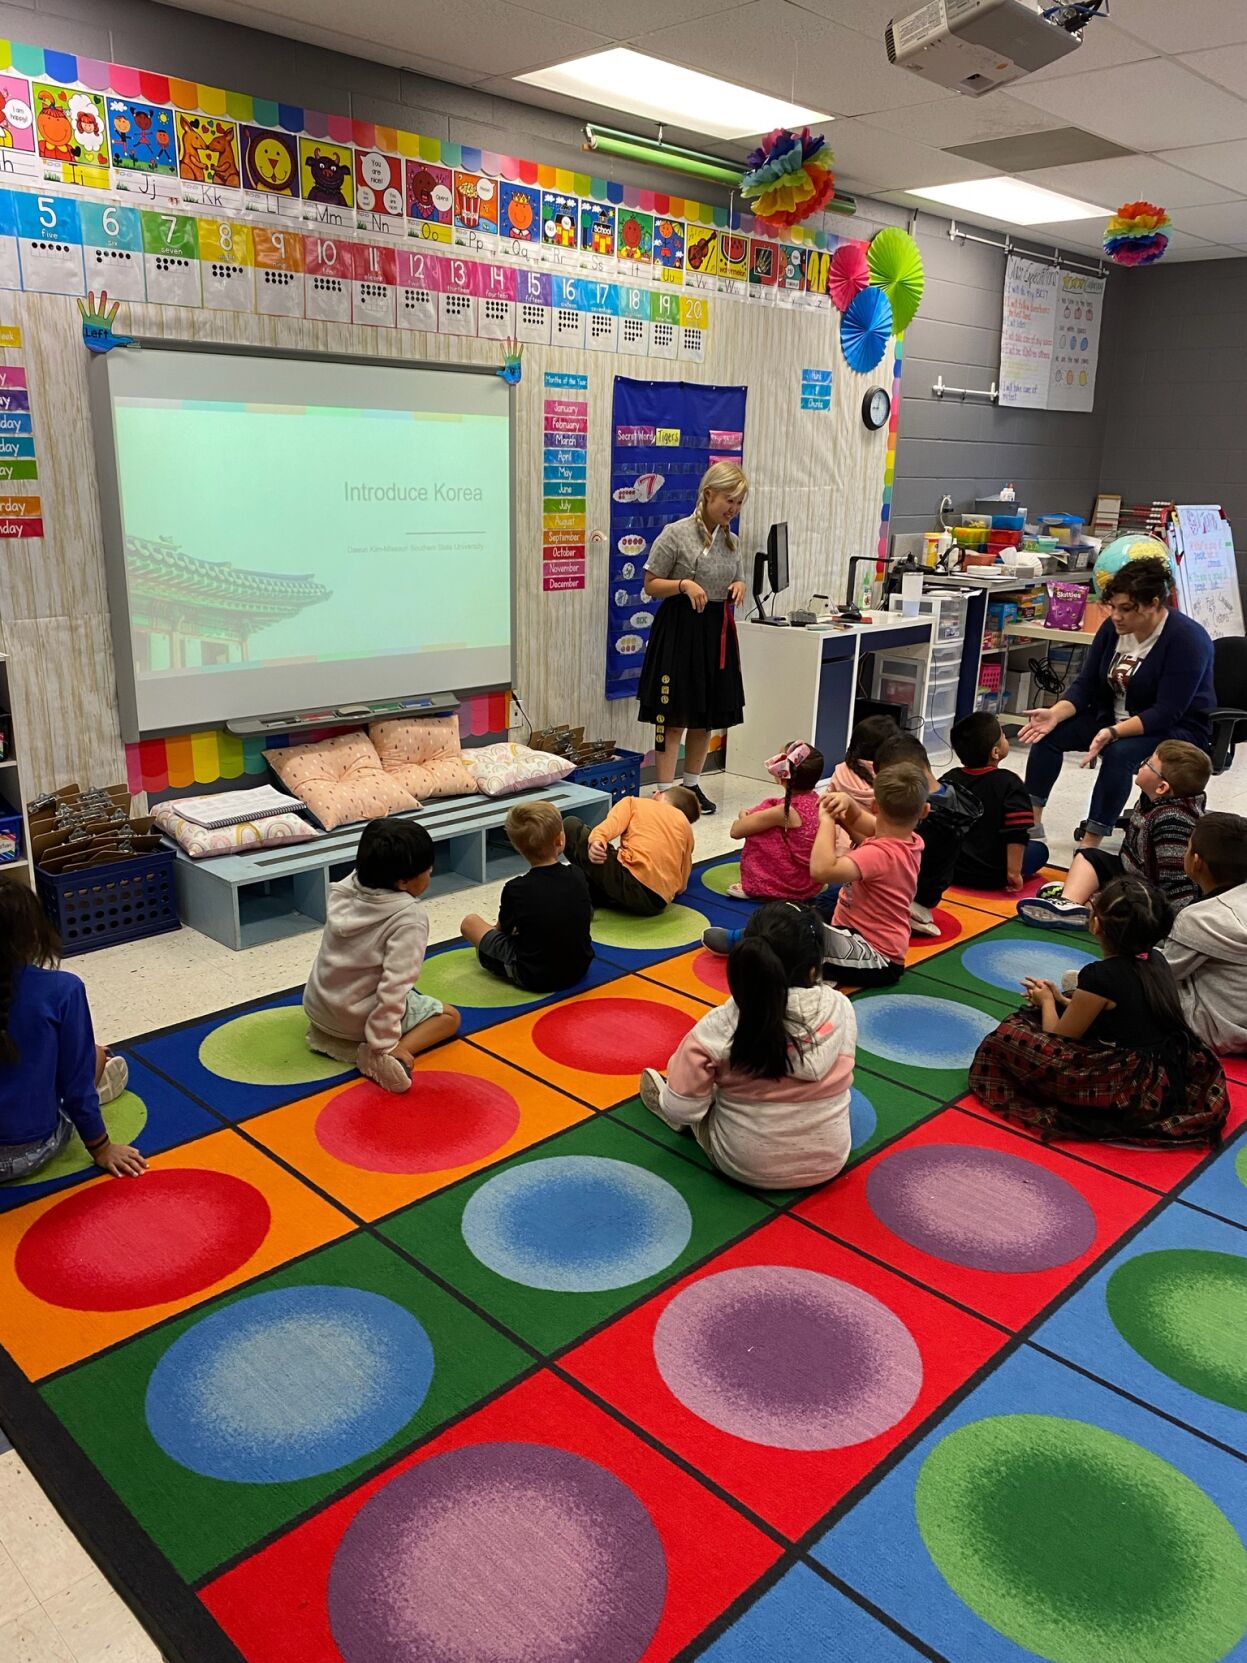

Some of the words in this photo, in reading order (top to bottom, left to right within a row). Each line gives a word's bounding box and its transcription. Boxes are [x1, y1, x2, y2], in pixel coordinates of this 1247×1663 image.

[139, 174, 156, 200] Jj
[202, 185, 222, 207] Kk
[37, 197, 57, 228] 5
[102, 207, 120, 236] 6
[315, 204, 343, 225] Mm
[161, 215, 177, 243] 7
[371, 213, 390, 233] Nn
[421, 223, 439, 241] Oo
[593, 225, 612, 235] School
[41, 229, 59, 240] five
[218, 223, 233, 251] 8
[469, 231, 484, 252] Pp
[271, 233, 286, 259] 9
[317, 239, 337, 265] 10
[369, 247, 378, 272] 11
[409, 254, 425, 278] 12
[450, 261, 466, 286] 13
[490, 266, 505, 289] 14
[527, 272, 541, 296] 15
[562, 279, 576, 301] 16
[596, 284, 609, 305] 17
[629, 289, 641, 310] 18
[659, 295, 671, 315] 19
[685, 299, 702, 319] 20
[85, 327, 109, 339] Left
[554, 402, 578, 415] January
[552, 418, 579, 432] February
[617, 429, 637, 441] Secret
[555, 434, 576, 445] March
[658, 429, 679, 445] Tigers
[558, 451, 572, 463] April
[559, 467, 572, 480] May
[344, 481, 428, 502] Introduce
[434, 482, 483, 502] Korea
[559, 484, 572, 493] June
[639, 474, 656, 499] 7
[559, 500, 571, 512] July
[555, 515, 575, 528] August
[549, 531, 579, 543] September
[552, 548, 576, 557] October
[549, 563, 580, 573] November
[549, 578, 579, 588] December
